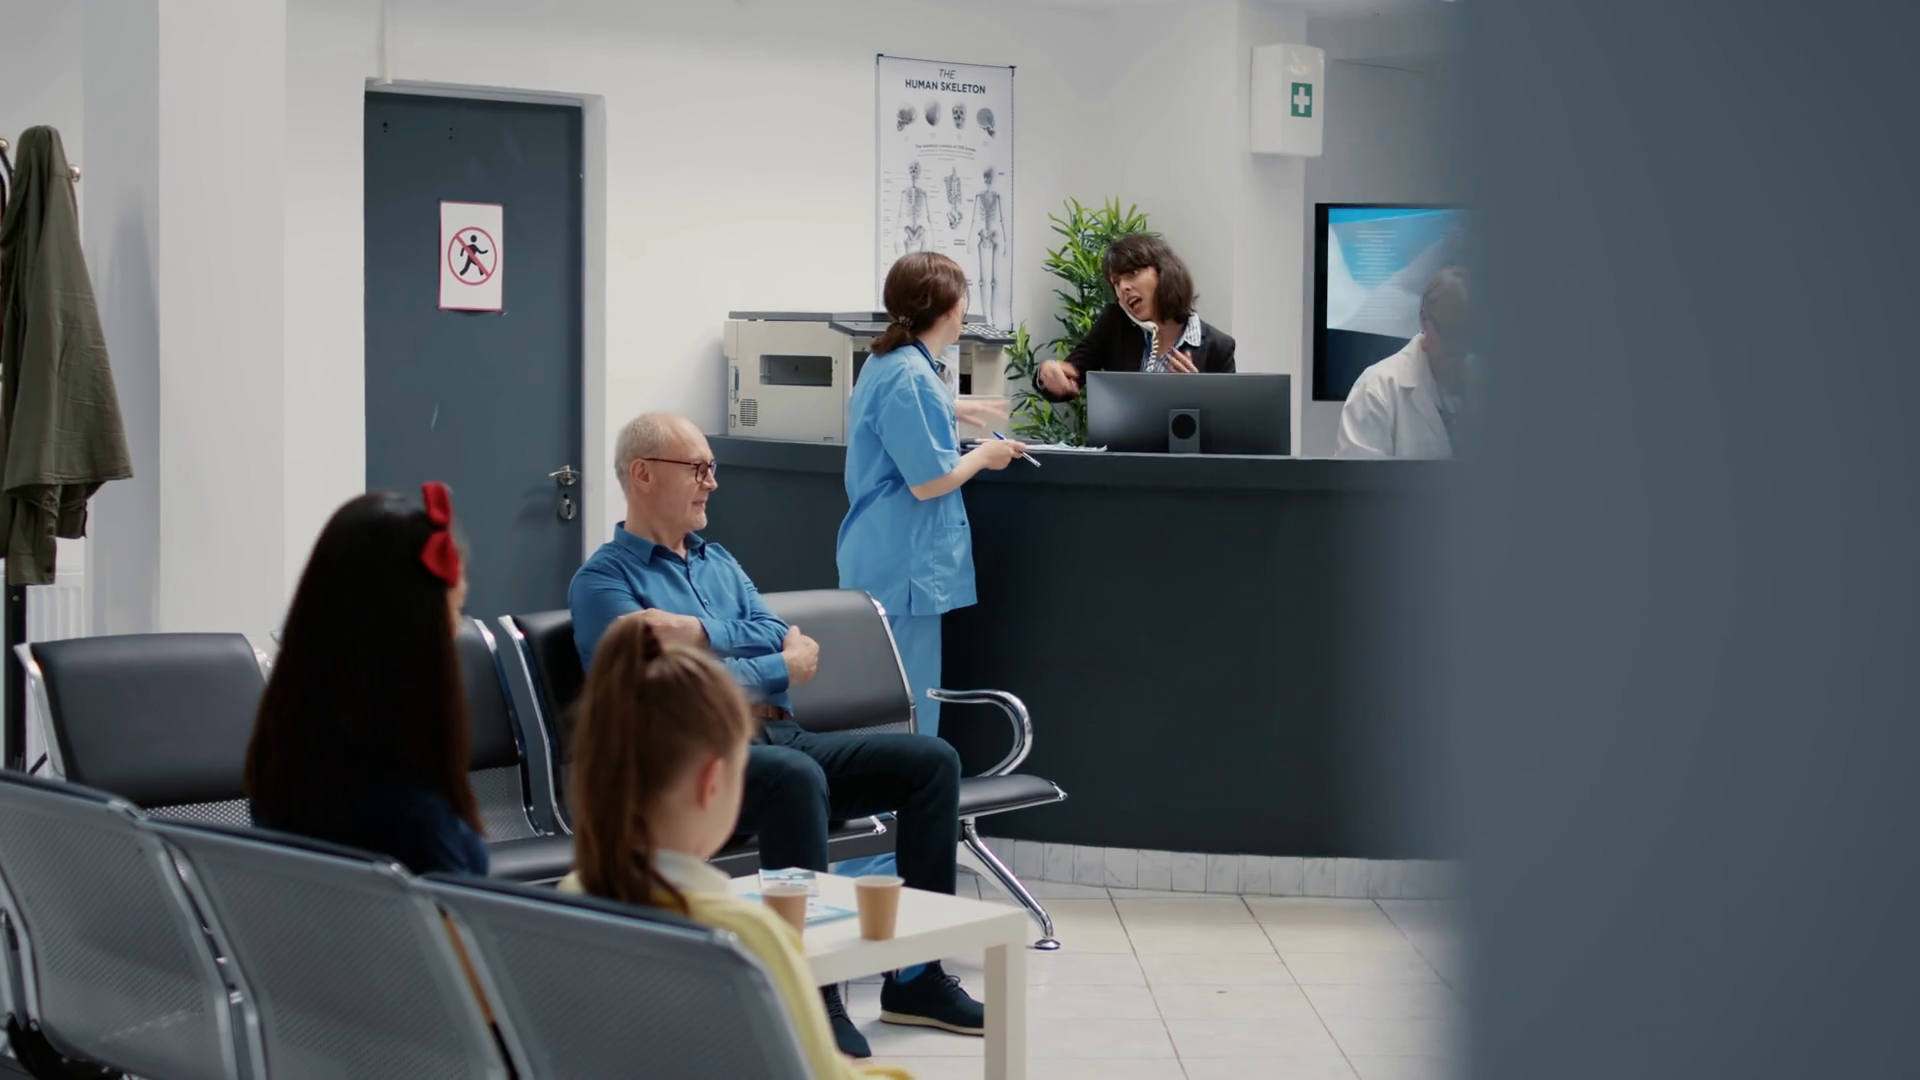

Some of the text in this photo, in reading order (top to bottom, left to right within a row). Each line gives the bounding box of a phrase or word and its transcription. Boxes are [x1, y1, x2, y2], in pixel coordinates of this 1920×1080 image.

[939, 68, 956, 80] THE
[905, 79, 986, 94] HUMAN SKELETON
